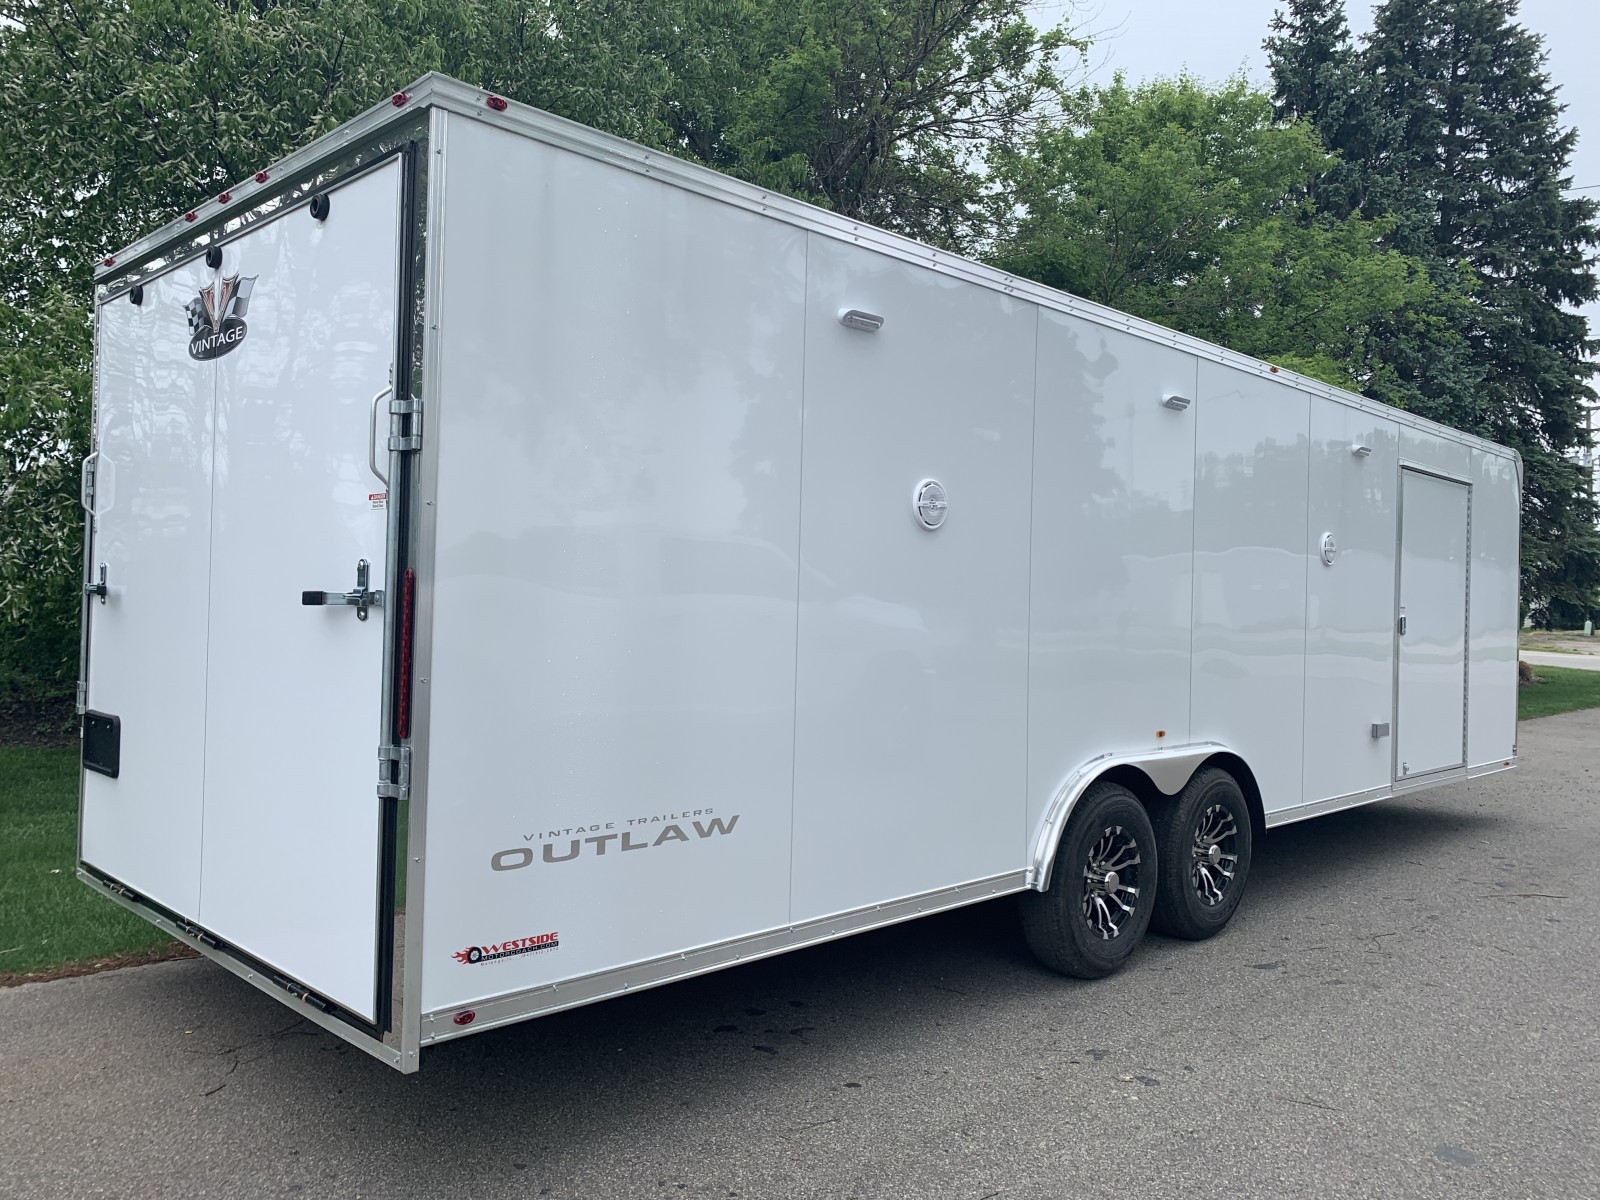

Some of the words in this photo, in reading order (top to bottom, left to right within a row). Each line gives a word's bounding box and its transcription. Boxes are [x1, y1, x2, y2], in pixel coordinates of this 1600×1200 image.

[191, 326, 243, 354] VINTAGE
[523, 822, 615, 841] VINTAGE
[627, 808, 714, 826] TRAILERS
[490, 814, 740, 872] OUTLAW
[481, 931, 559, 954] WESTSIDE
[482, 942, 559, 961] MOTORCOACH.COM
